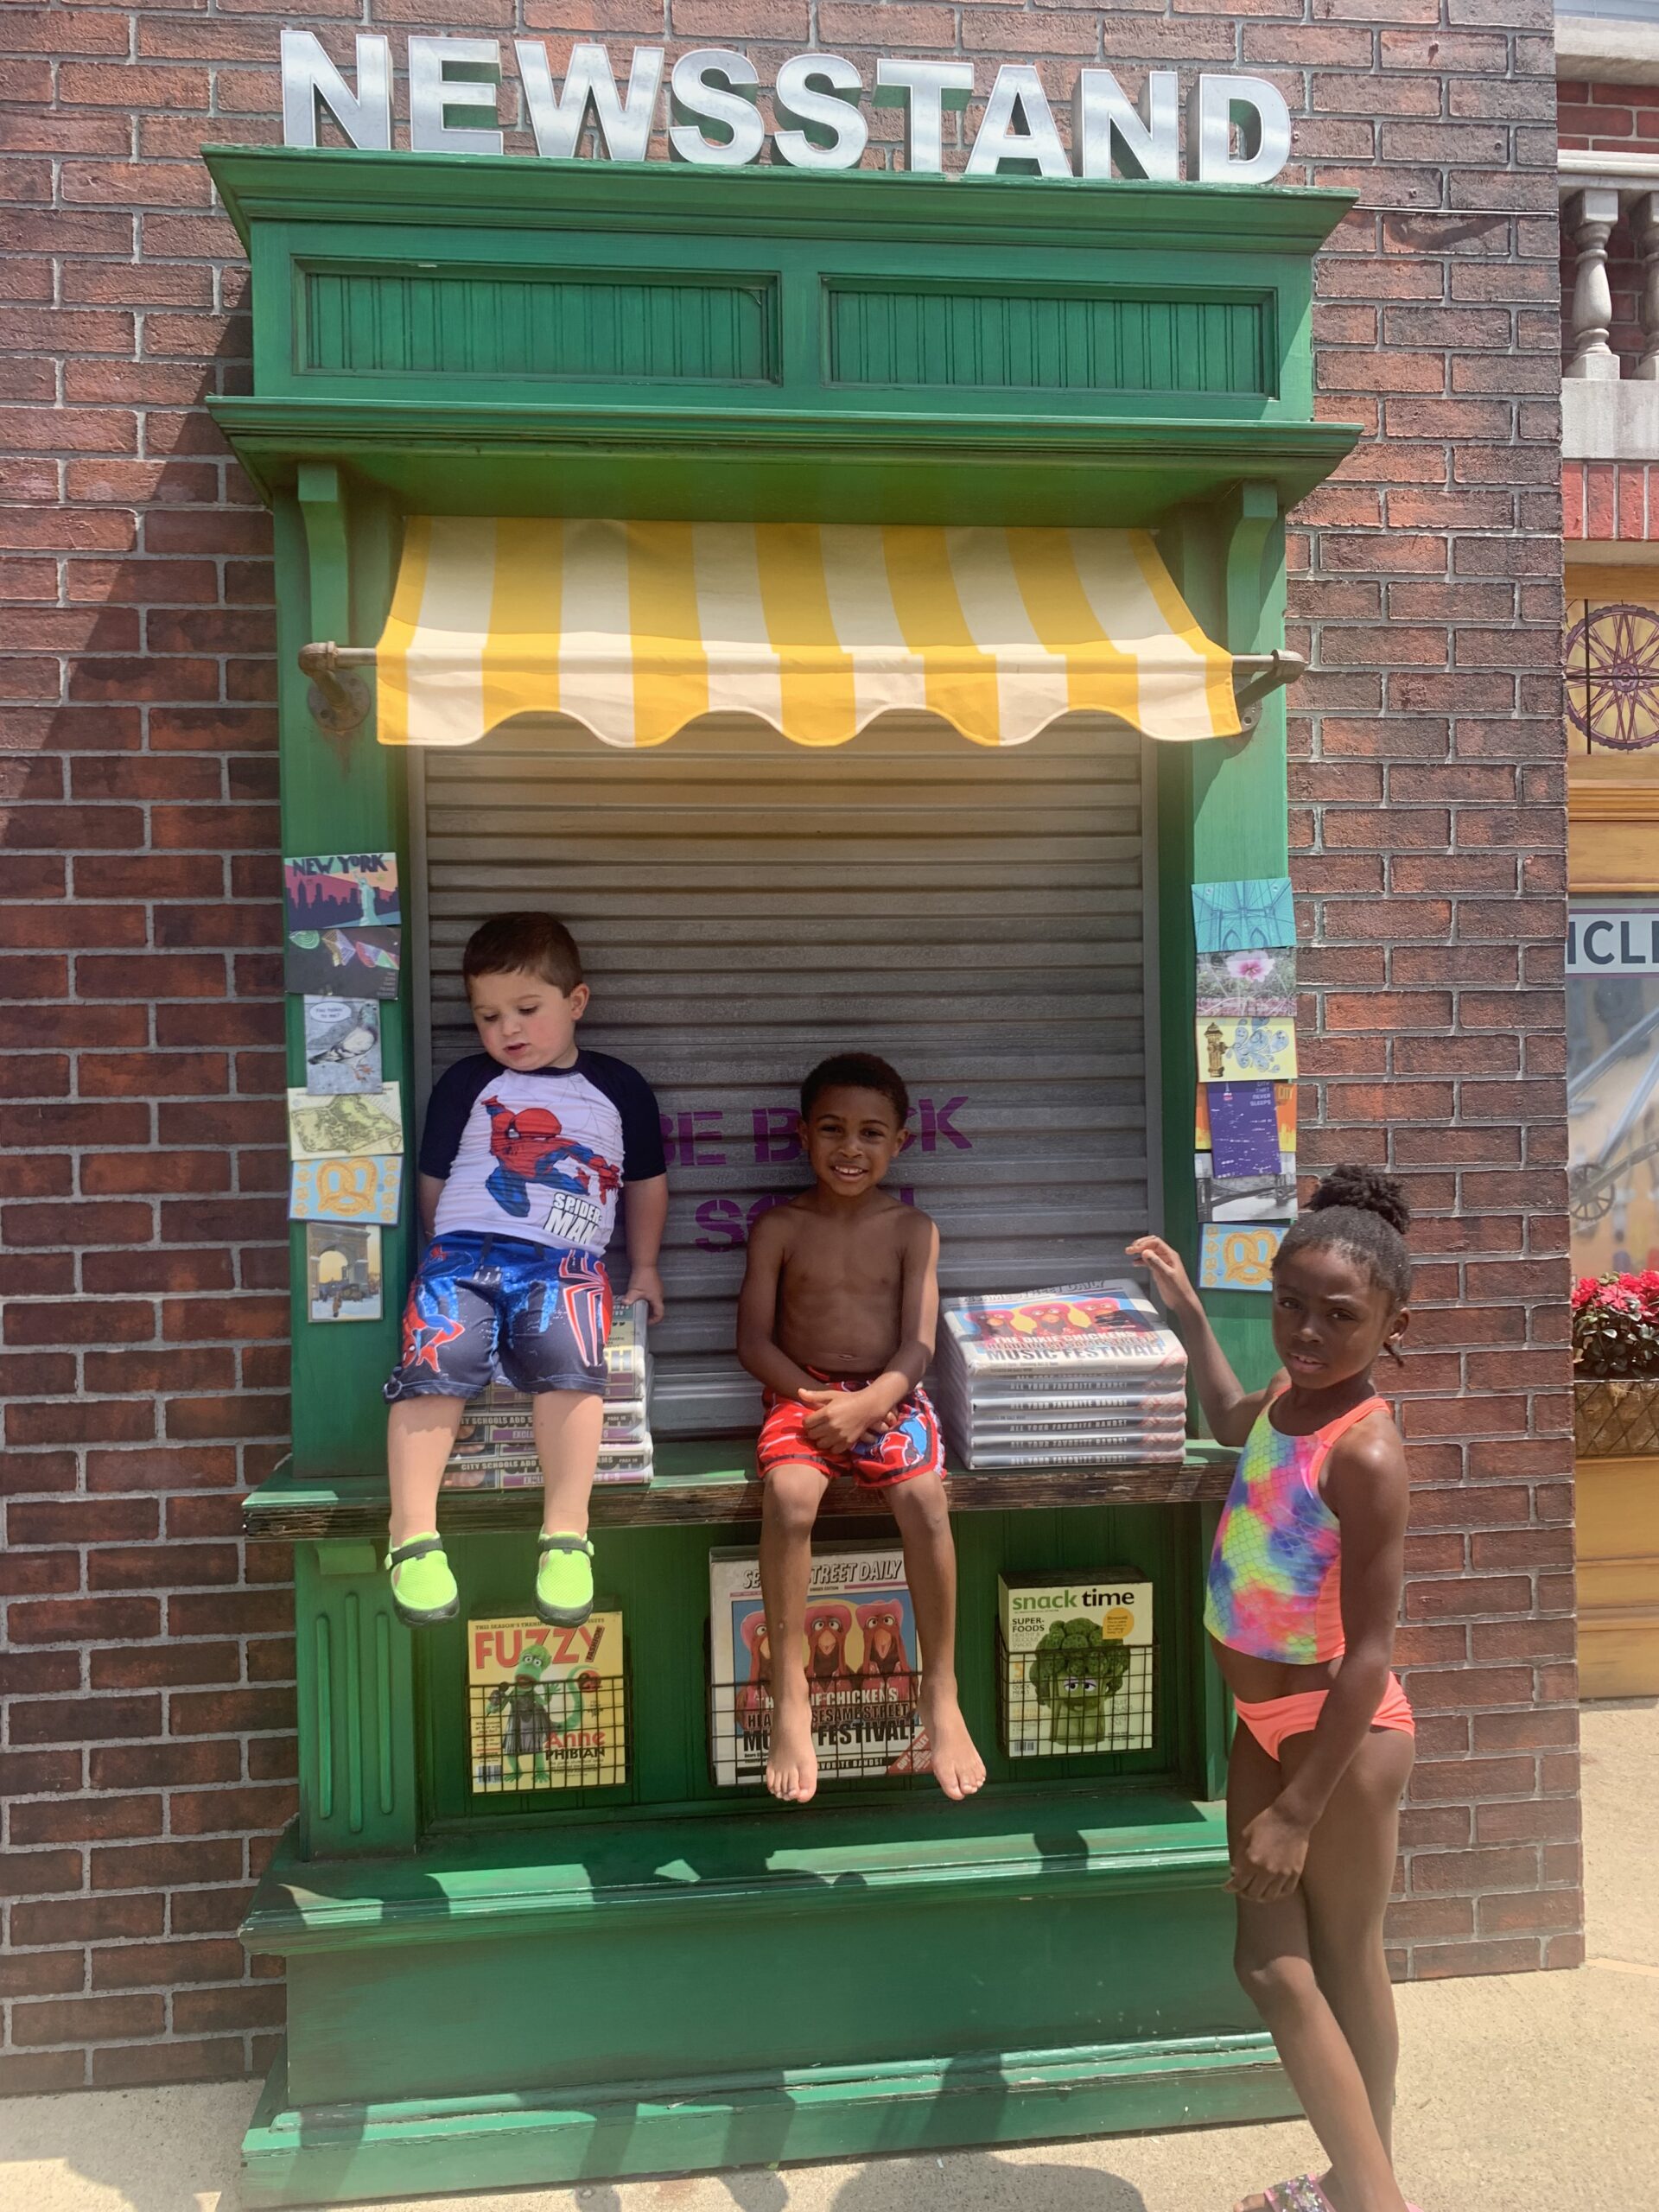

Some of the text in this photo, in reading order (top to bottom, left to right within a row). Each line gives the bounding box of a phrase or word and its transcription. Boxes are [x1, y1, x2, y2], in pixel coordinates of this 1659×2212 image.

[280, 29, 1292, 187] NEWSSTAND
[292, 854, 388, 877] NEW YORK
[753, 1096, 973, 1163] BK
[543, 1206, 599, 1244] MAN
[987, 1340, 1166, 1362] MUSIC FESTIVAL!
[995, 1336, 1021, 1344] THE
[472, 1416, 508, 1425] SCHOOLS
[512, 1429, 534, 1440] EXCLU
[461, 1463, 480, 1471] CITY
[481, 1460, 518, 1470] SCHOOLS
[809, 1560, 903, 1585] TREET DAILY
[1012, 1588, 1135, 1611] snack time
[1012, 1624, 1045, 1633] FOODS
[475, 1626, 605, 1669] FUZZY
[586, 1625, 605, 1662] FASHION
[755, 1695, 774, 1709] TH
[826, 1687, 899, 1706] CHICKENS
[864, 1702, 910, 1719] STREET
[544, 1731, 607, 1749] Anne
[817, 1717, 916, 1746] FESTIVAL!
[544, 1747, 606, 1761] PHIBIAN
